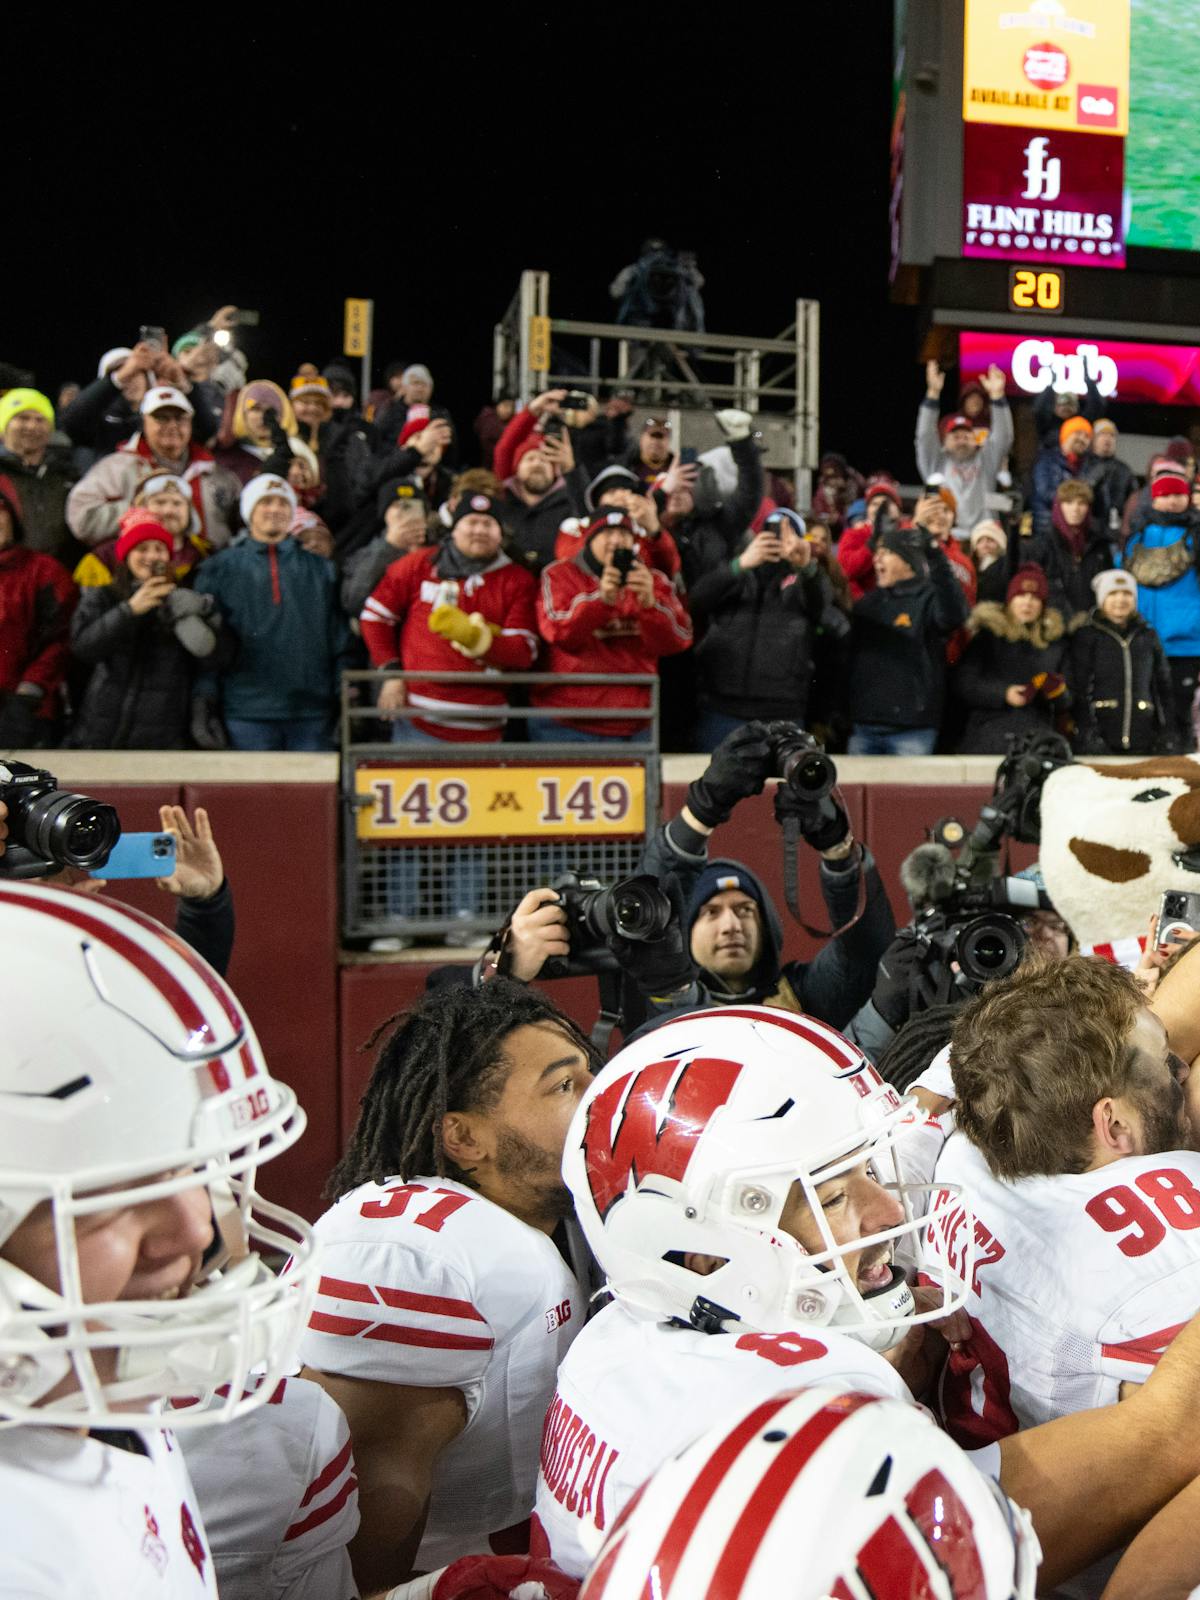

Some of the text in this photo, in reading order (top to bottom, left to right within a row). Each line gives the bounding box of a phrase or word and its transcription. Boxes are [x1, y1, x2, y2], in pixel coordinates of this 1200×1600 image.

[966, 203, 1113, 239] FLINT HILLS
[1013, 271, 1061, 309] 20
[1012, 339, 1118, 397] Cub
[374, 783, 468, 824] 148
[541, 780, 629, 821] 149
[360, 1184, 473, 1232] 37
[735, 1331, 829, 1367] 8
